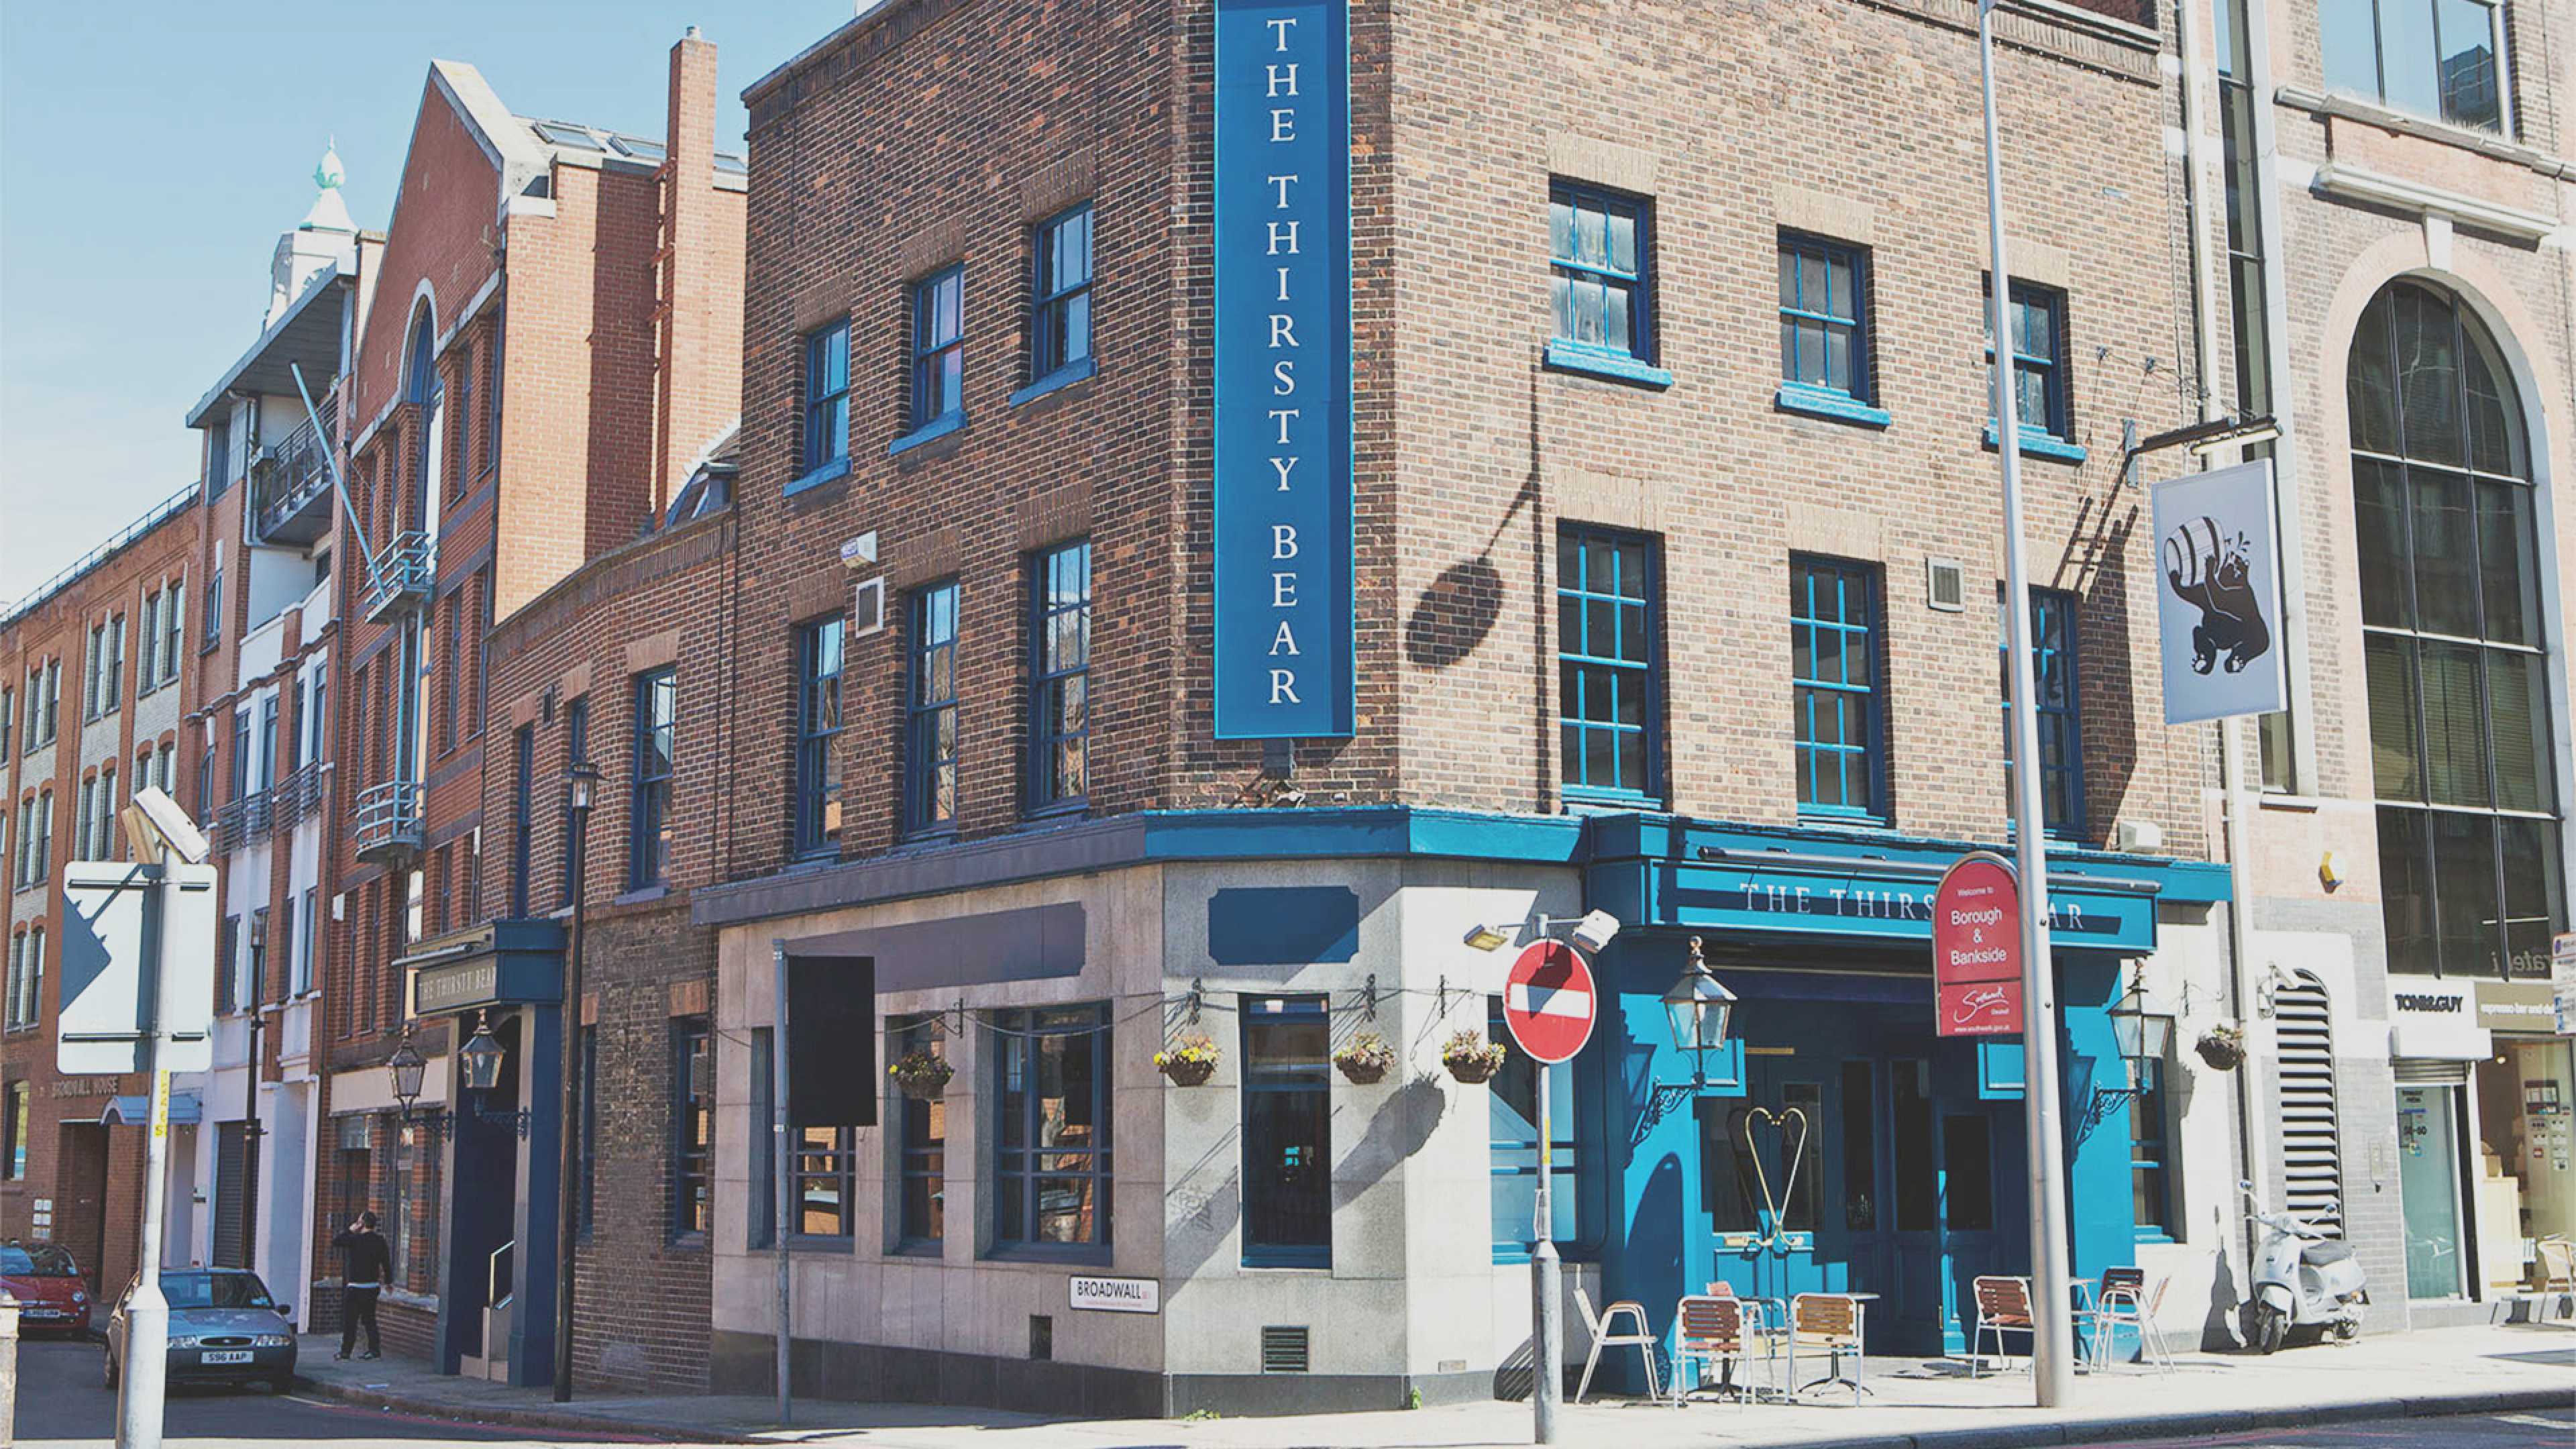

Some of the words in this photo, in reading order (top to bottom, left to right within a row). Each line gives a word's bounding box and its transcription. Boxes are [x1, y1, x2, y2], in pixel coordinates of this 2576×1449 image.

[1266, 17, 1299, 143] THE
[1266, 174, 1300, 491] THIRSTY
[1267, 525, 1301, 704] BEAR
[1739, 882, 1811, 914] THE
[1829, 888, 1935, 920] THIRS
[1950, 906, 2002, 926] Borough
[1973, 928, 1983, 943] &
[1950, 947, 2007, 966] Bankside
[1077, 1280, 1141, 1299] BROADWALL
